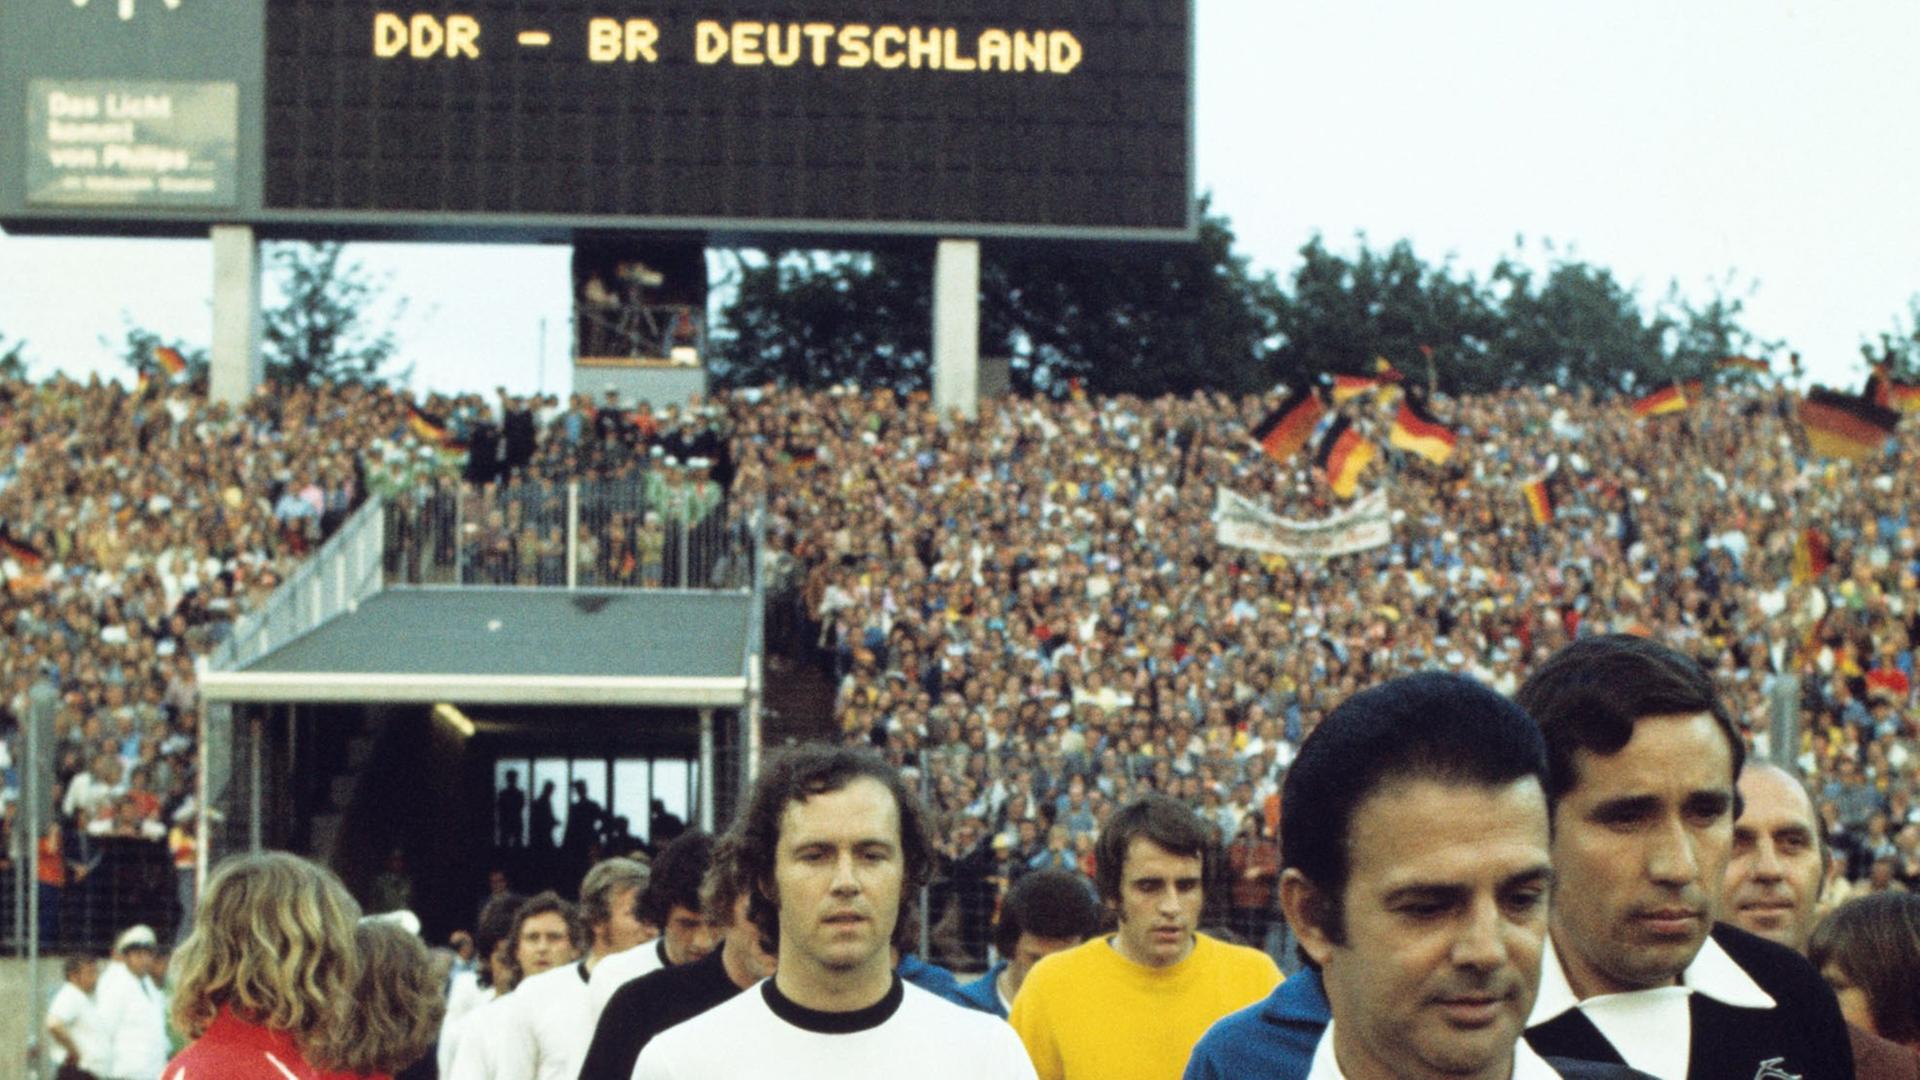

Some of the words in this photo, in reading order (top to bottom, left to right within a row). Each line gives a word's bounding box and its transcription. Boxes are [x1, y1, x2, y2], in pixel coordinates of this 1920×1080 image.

[373, 12, 480, 59] DDR
[588, 18, 659, 63] BR
[695, 20, 1083, 74] DEUTSCHLAND
[102, 144, 189, 172] Phps
